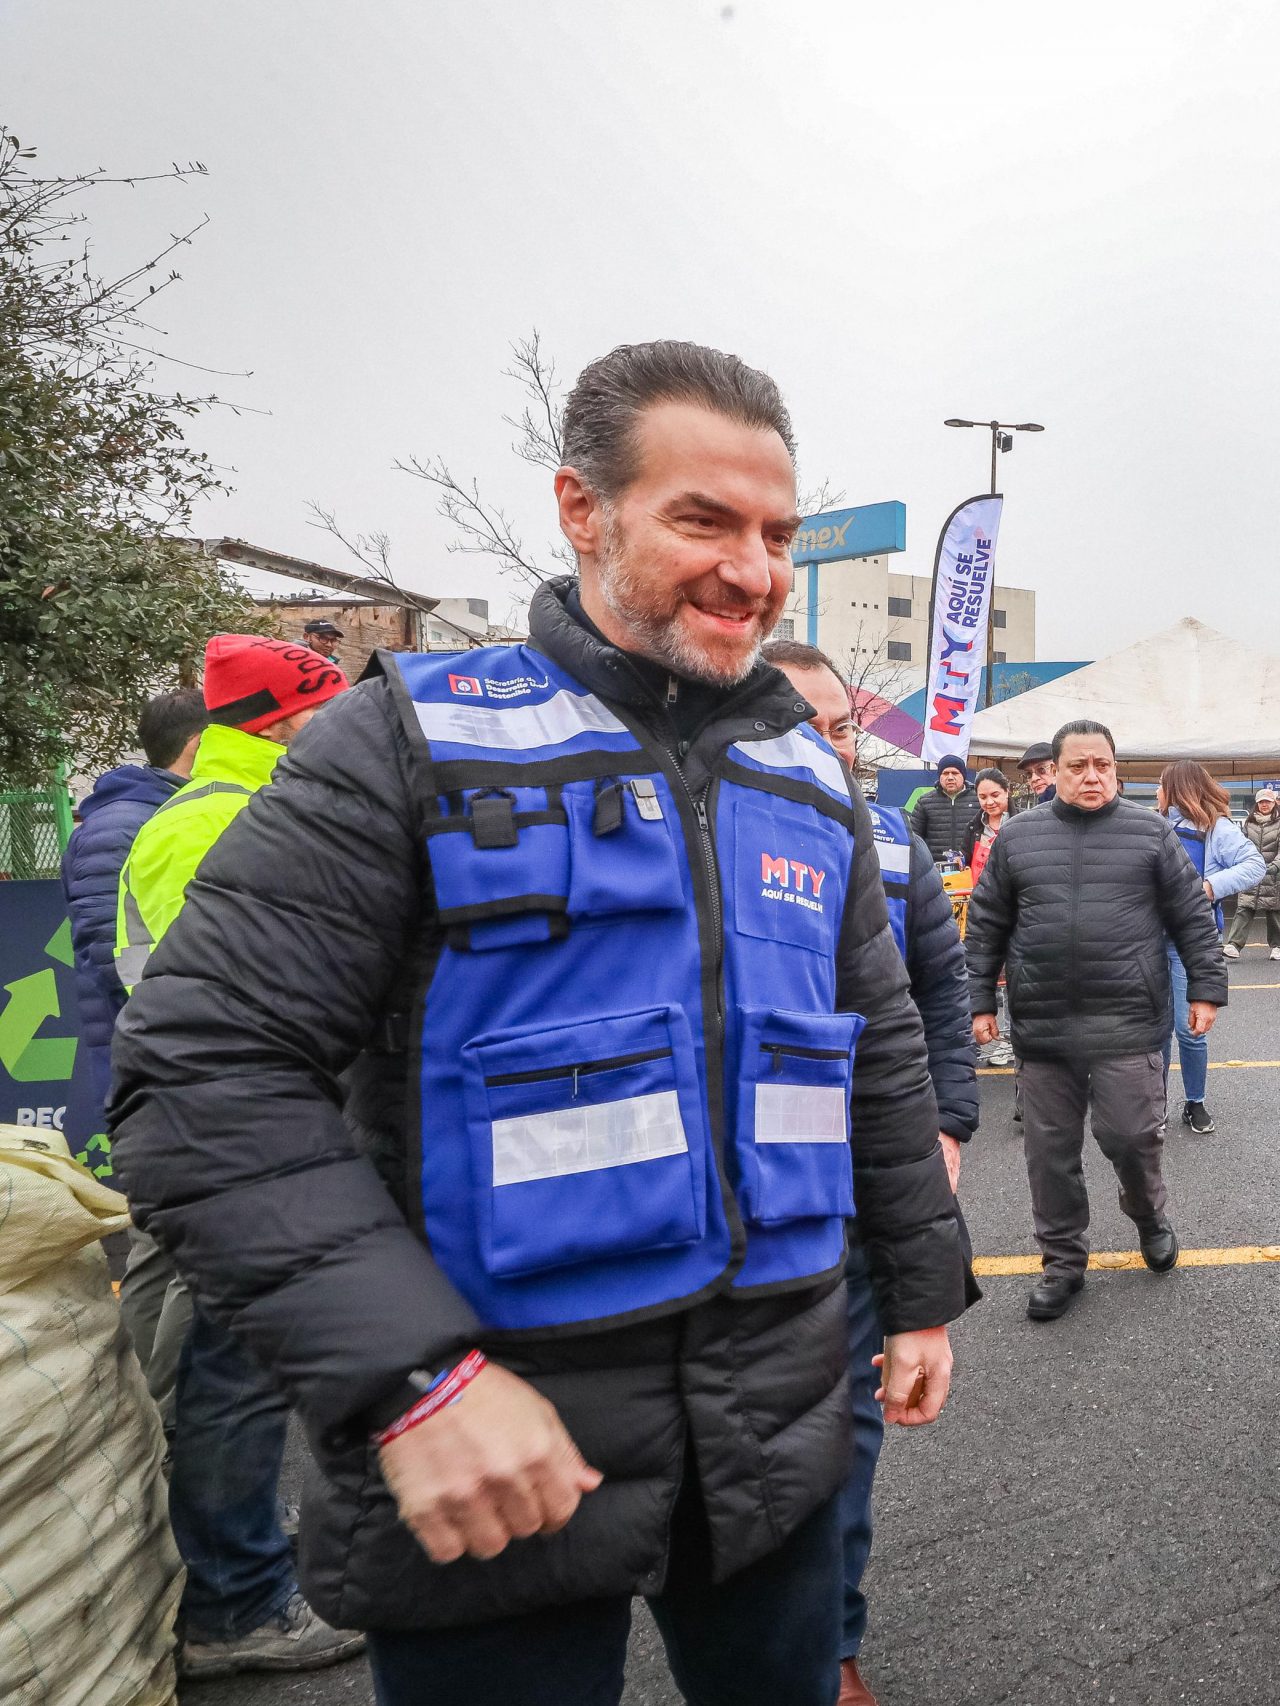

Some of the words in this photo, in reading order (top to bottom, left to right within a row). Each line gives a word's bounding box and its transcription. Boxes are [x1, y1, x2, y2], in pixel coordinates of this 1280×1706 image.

[792, 514, 856, 553] mex
[955, 552, 974, 576] SE
[961, 538, 992, 629] RESUELVE
[487, 689, 531, 699] Sostenible
[929, 624, 974, 737] MTY
[761, 852, 826, 898] MTY
[784, 893, 795, 903] SE
[16, 1105, 67, 1131] REC
